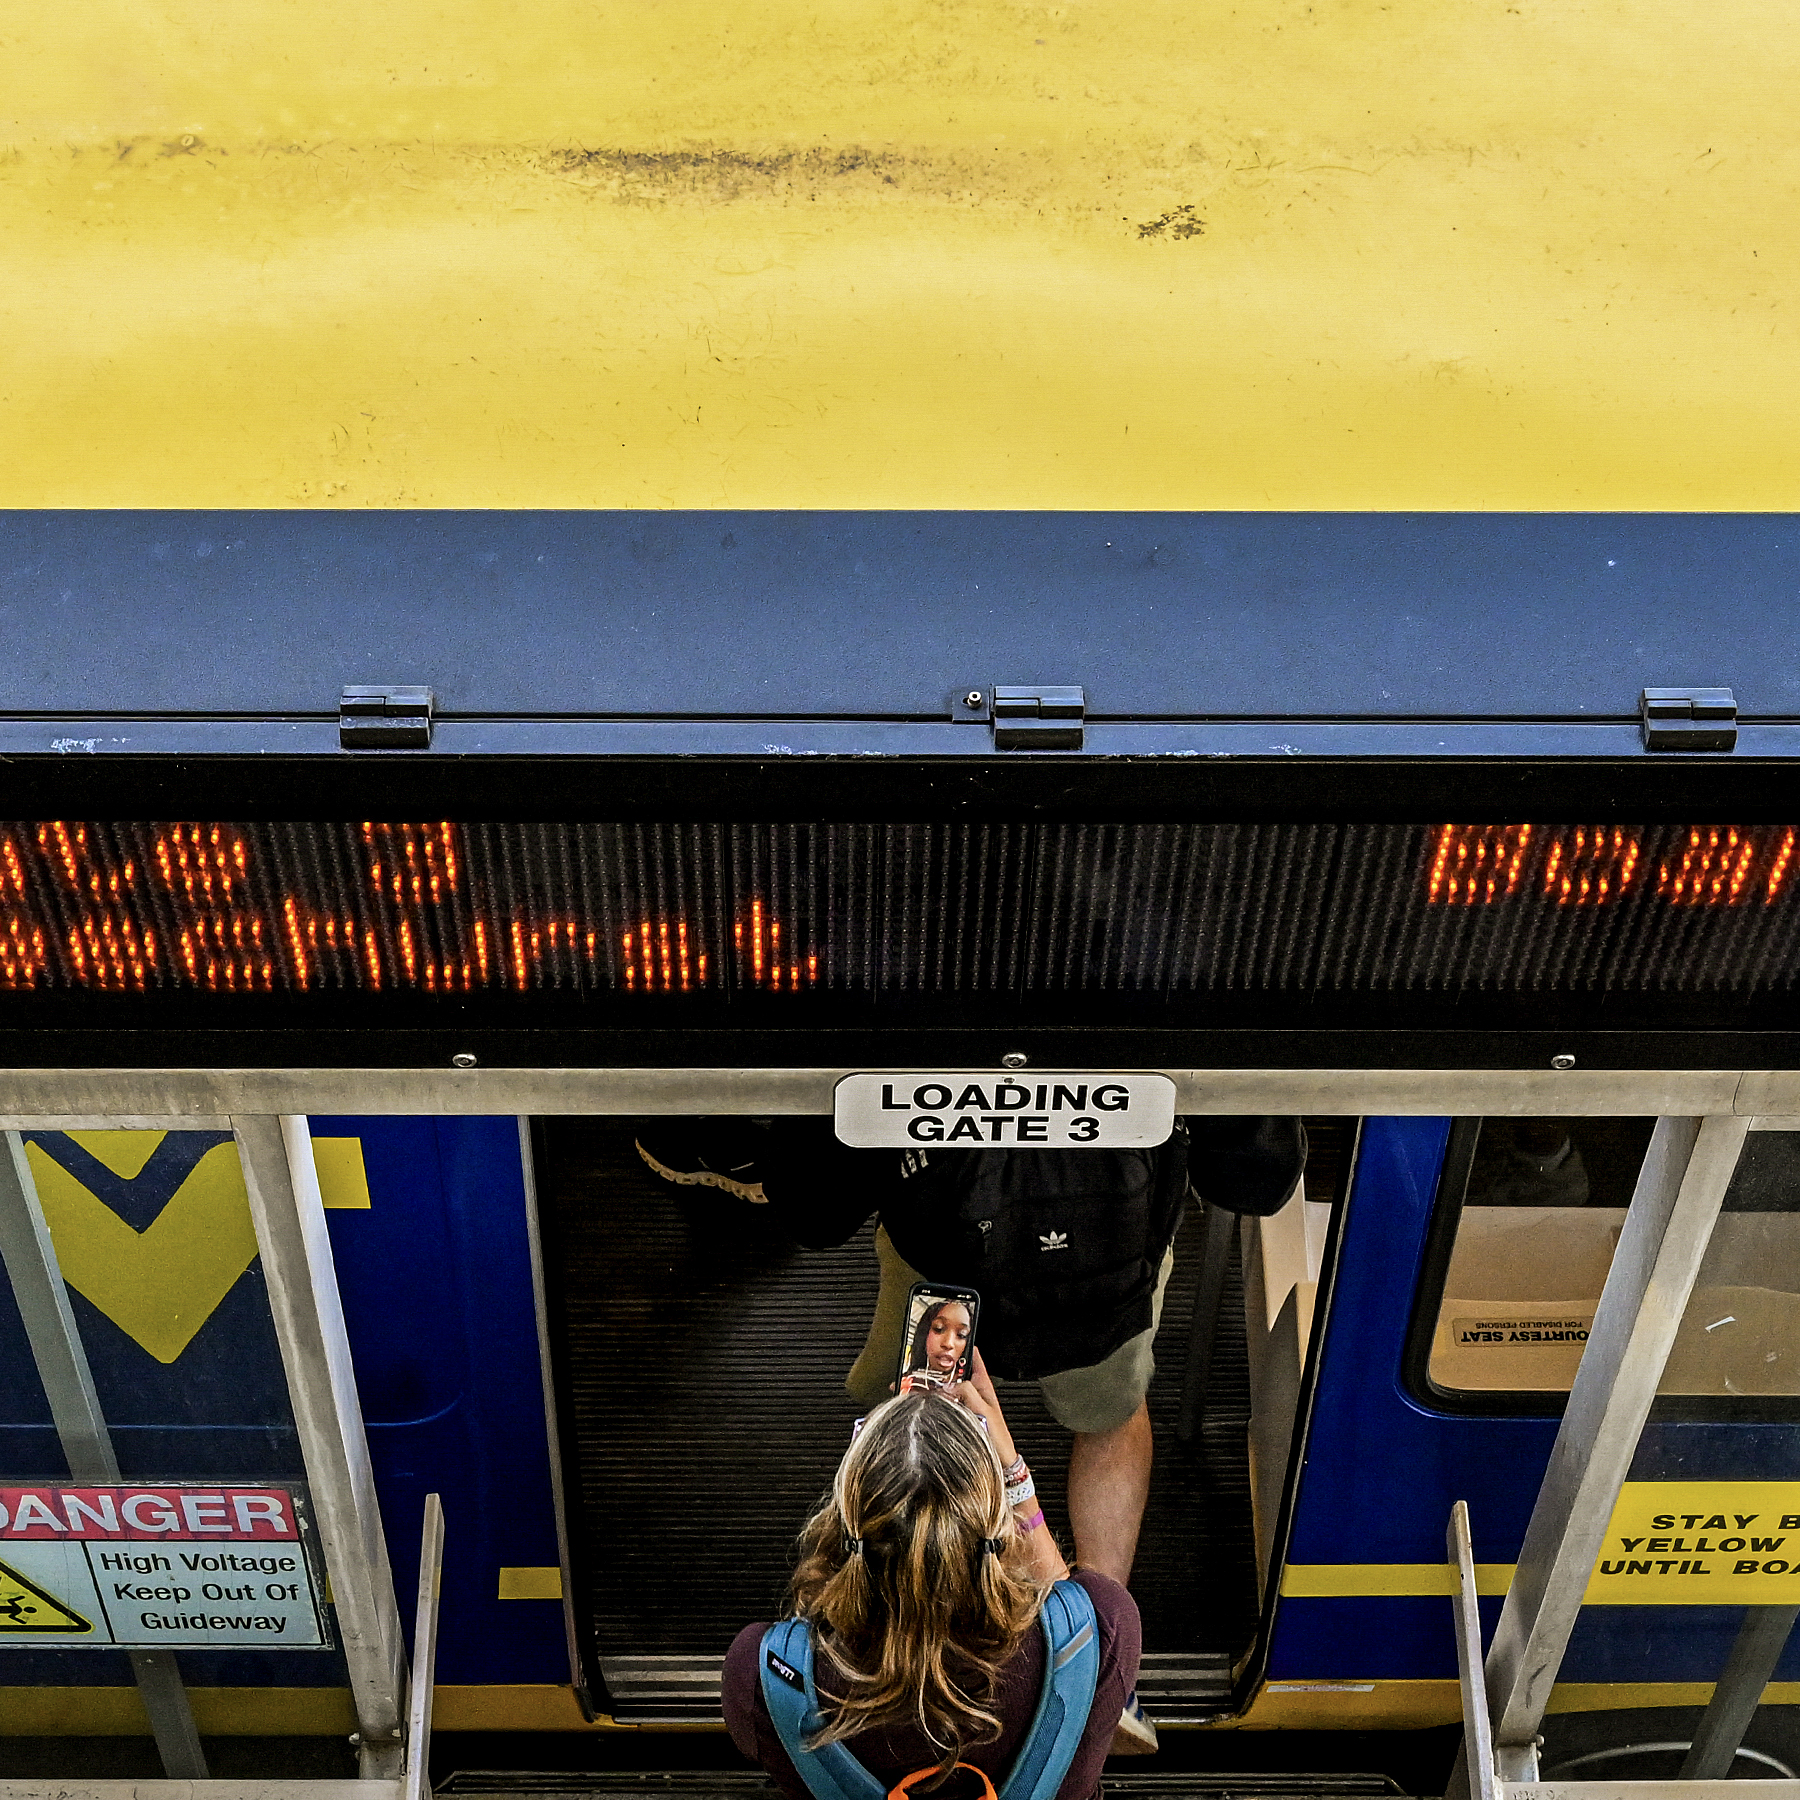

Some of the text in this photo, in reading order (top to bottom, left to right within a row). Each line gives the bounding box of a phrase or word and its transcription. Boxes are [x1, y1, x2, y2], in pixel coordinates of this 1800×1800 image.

[880, 1083, 1130, 1112] LOADING
[907, 1116, 1101, 1142] GATE 3
[1519, 1321, 1563, 1329] DISABLED
[1461, 1330, 1590, 1342] OURTESY SEAT
[1649, 1514, 1760, 1529] STAY
[1620, 1537, 1786, 1552] YELLOW
[100, 1552, 297, 1574] High Voltage
[1599, 1560, 1711, 1575] UNTIL
[113, 1582, 300, 1603] Keep Out Of
[140, 1612, 287, 1633] Guideway
